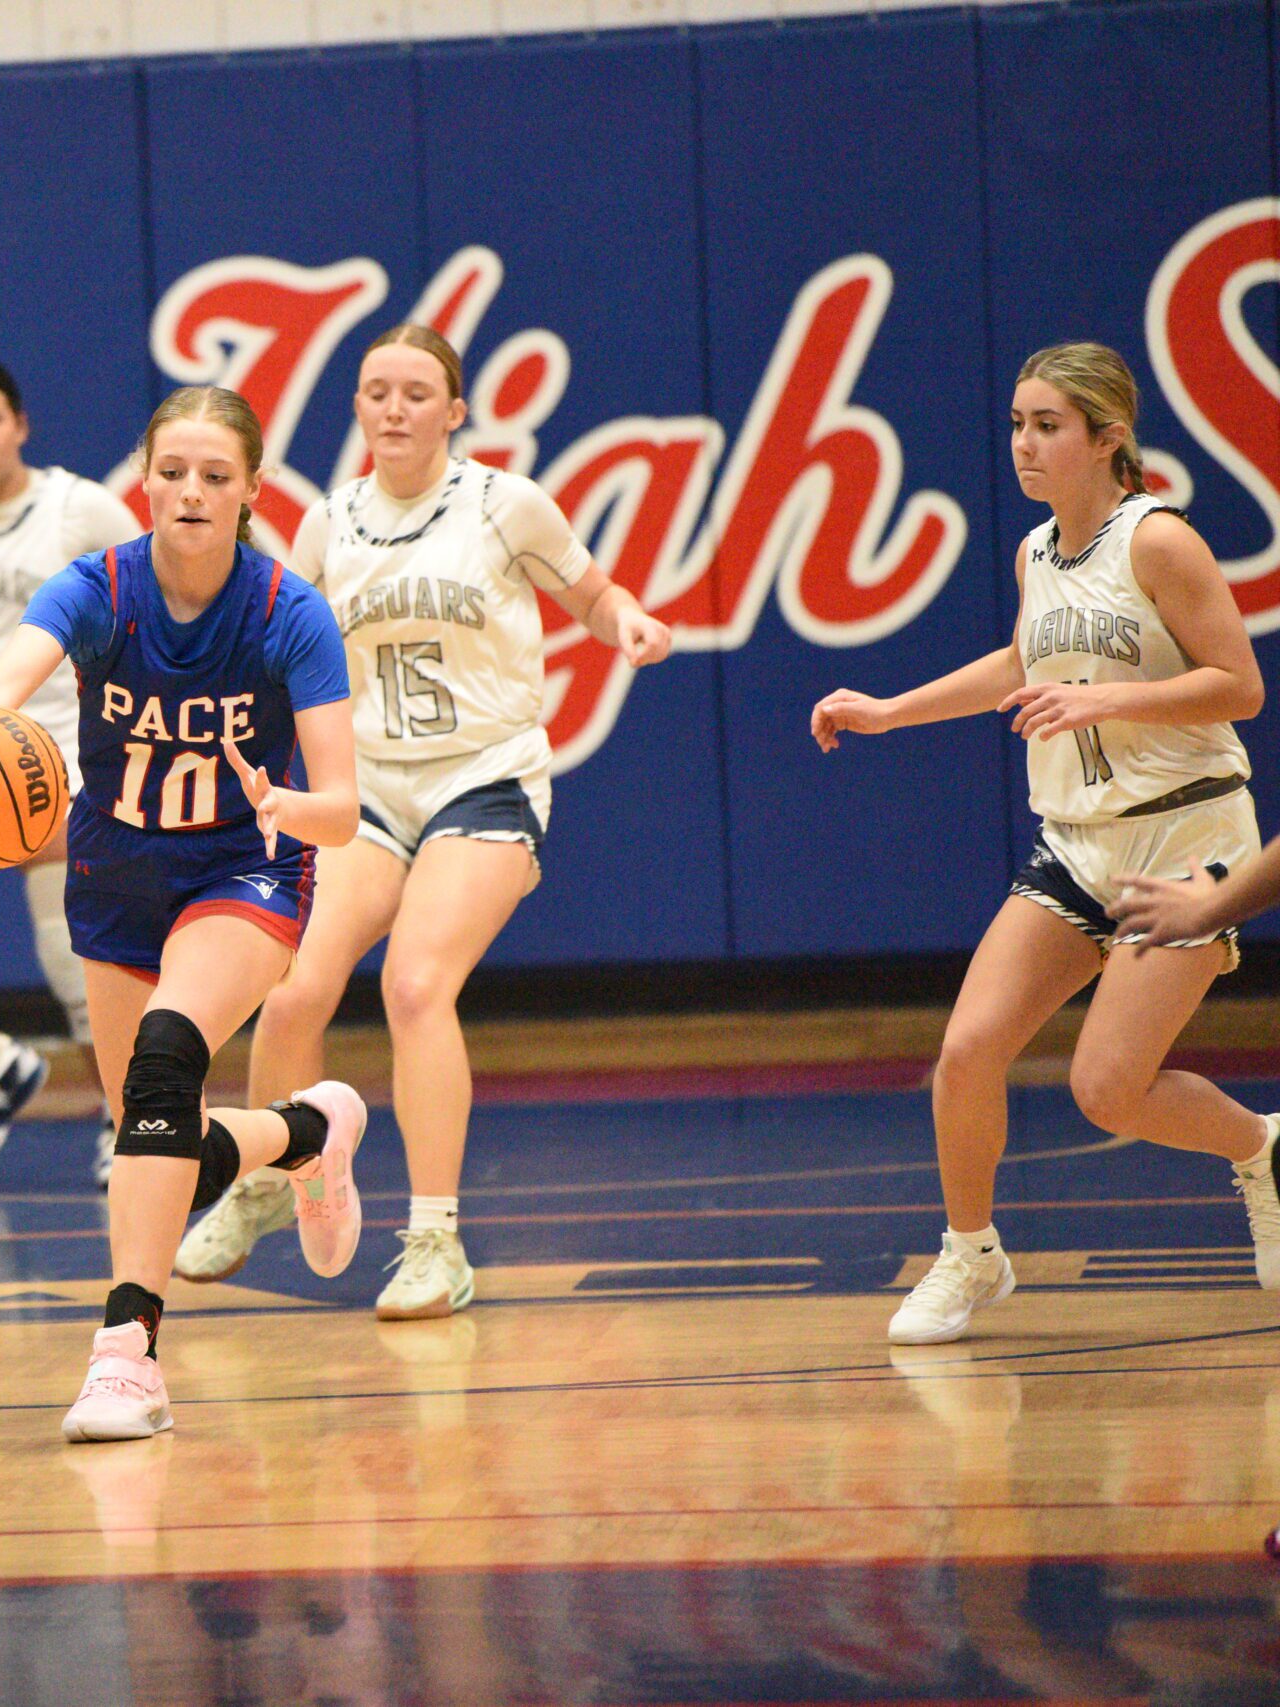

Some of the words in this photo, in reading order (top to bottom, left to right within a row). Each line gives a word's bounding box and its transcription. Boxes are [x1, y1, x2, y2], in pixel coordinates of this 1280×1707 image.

[1026, 606, 1141, 670] AGUARS
[100, 681, 256, 744] PACE
[376, 641, 458, 739] 15
[112, 742, 219, 832] 10
